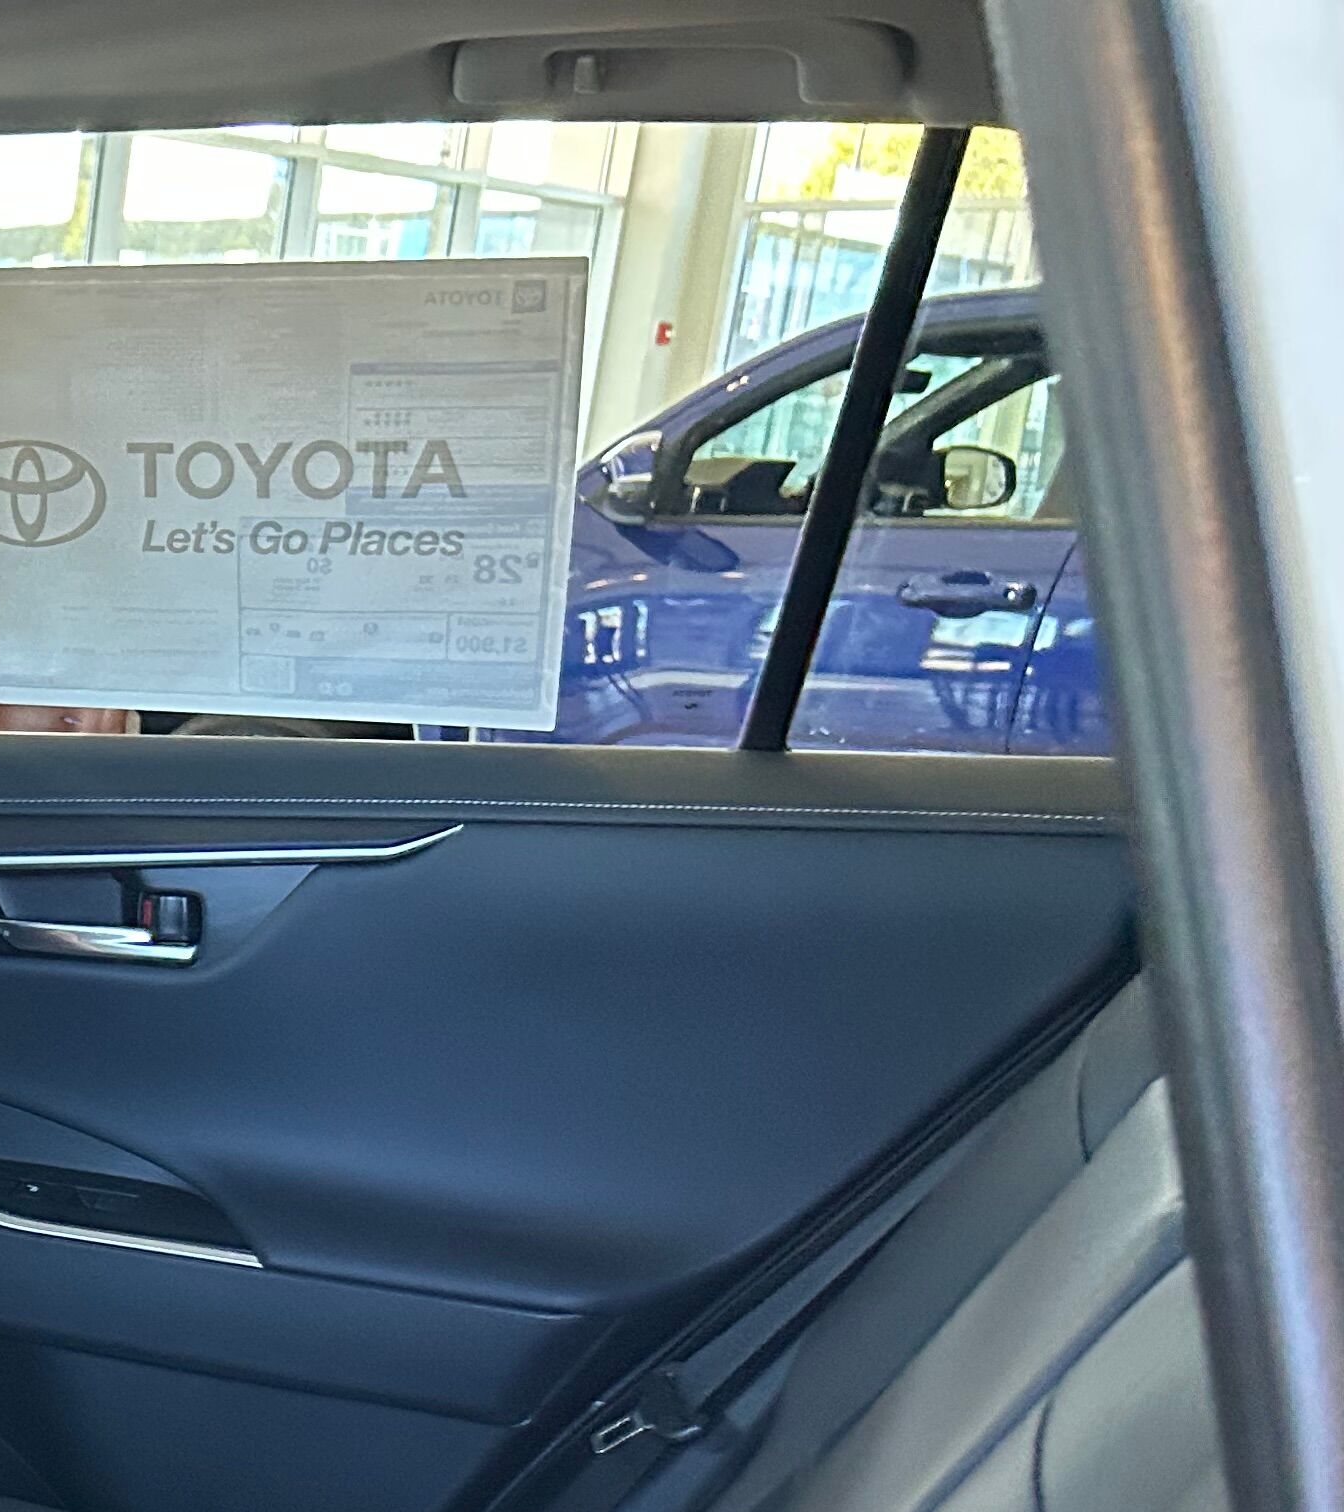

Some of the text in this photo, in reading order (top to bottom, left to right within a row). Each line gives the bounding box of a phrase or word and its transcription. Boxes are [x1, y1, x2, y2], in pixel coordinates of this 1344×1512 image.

[126, 440, 467, 500] TOYOTA
[142, 520, 236, 555] Let's
[249, 521, 309, 555] Go
[319, 520, 464, 557] Places
